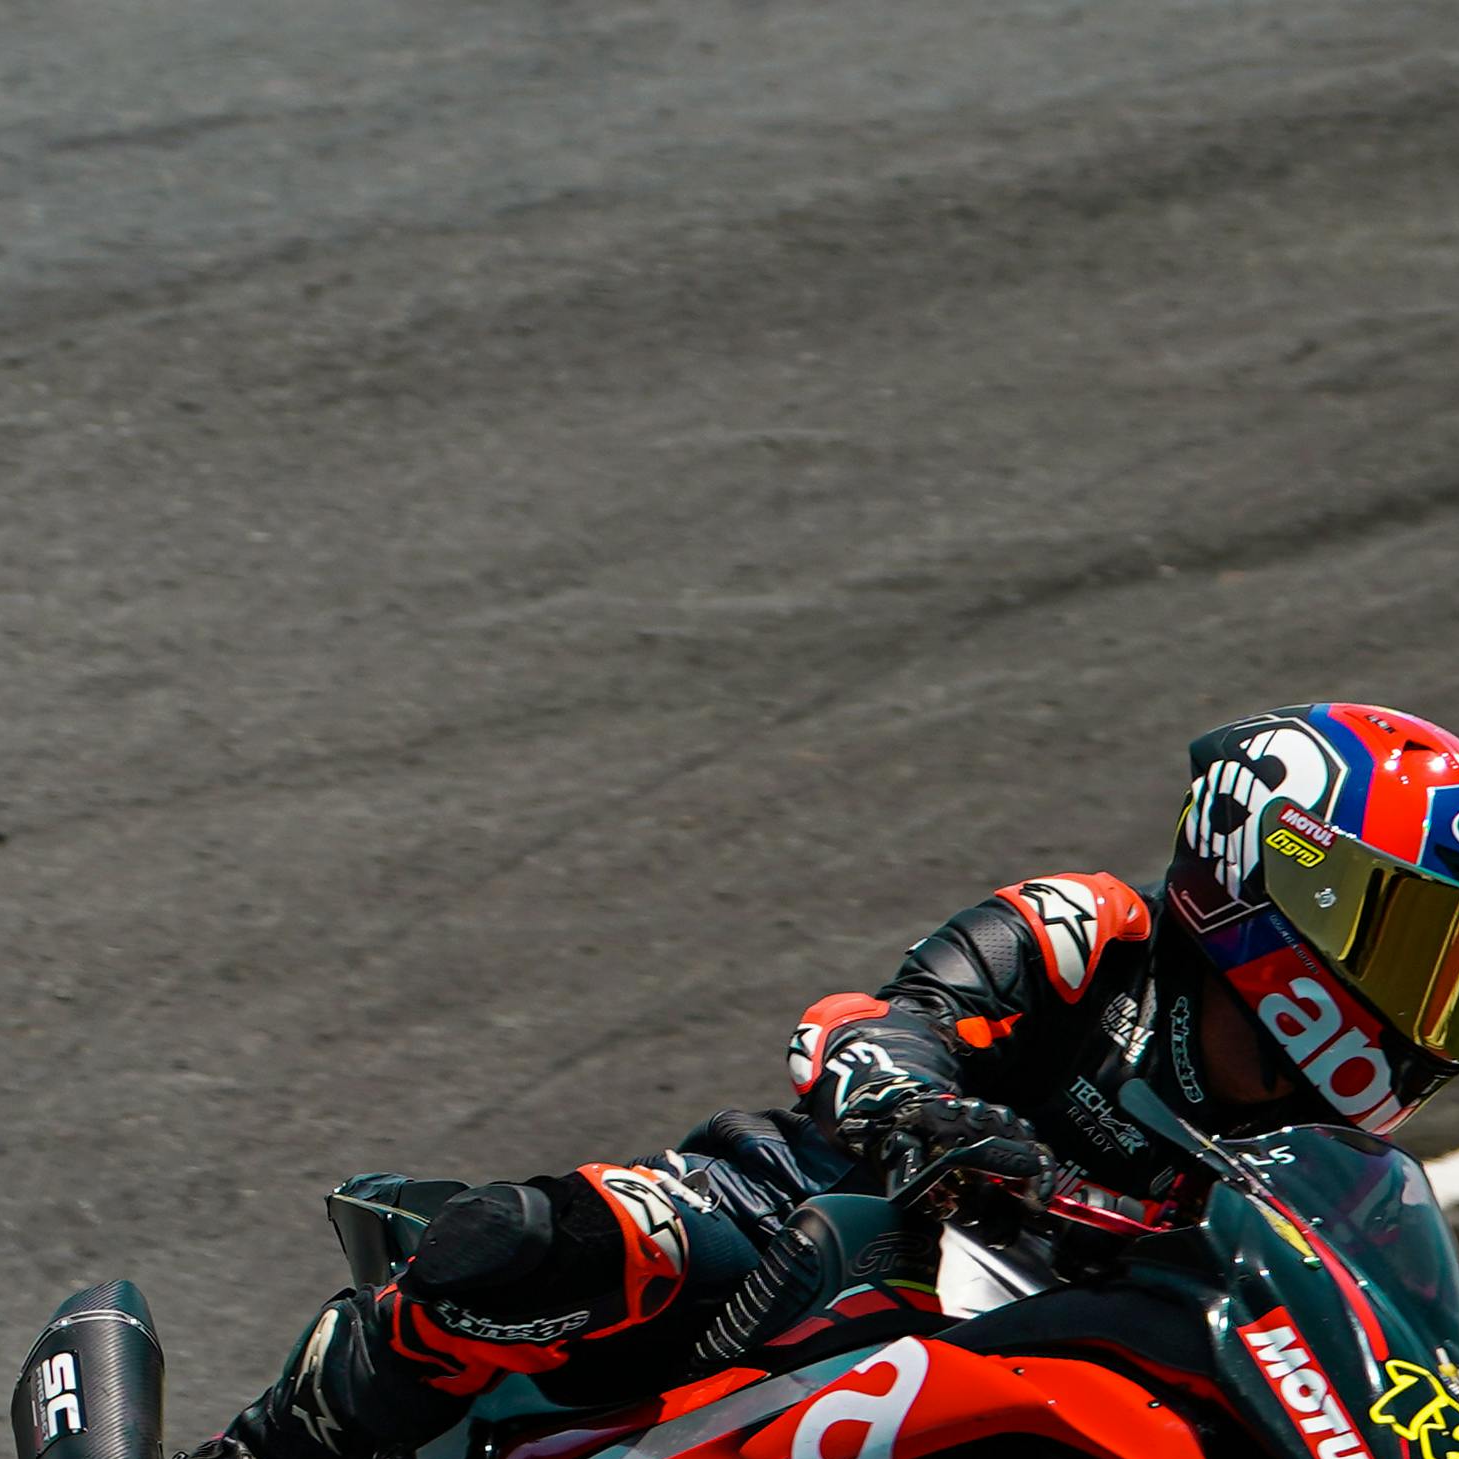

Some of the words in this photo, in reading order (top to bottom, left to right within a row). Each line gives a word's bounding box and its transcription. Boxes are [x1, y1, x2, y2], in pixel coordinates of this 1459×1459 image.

[1282, 808, 1334, 847] MOTUL
[1066, 1105, 1114, 1152] READY
[42, 1352, 81, 1437] SC
